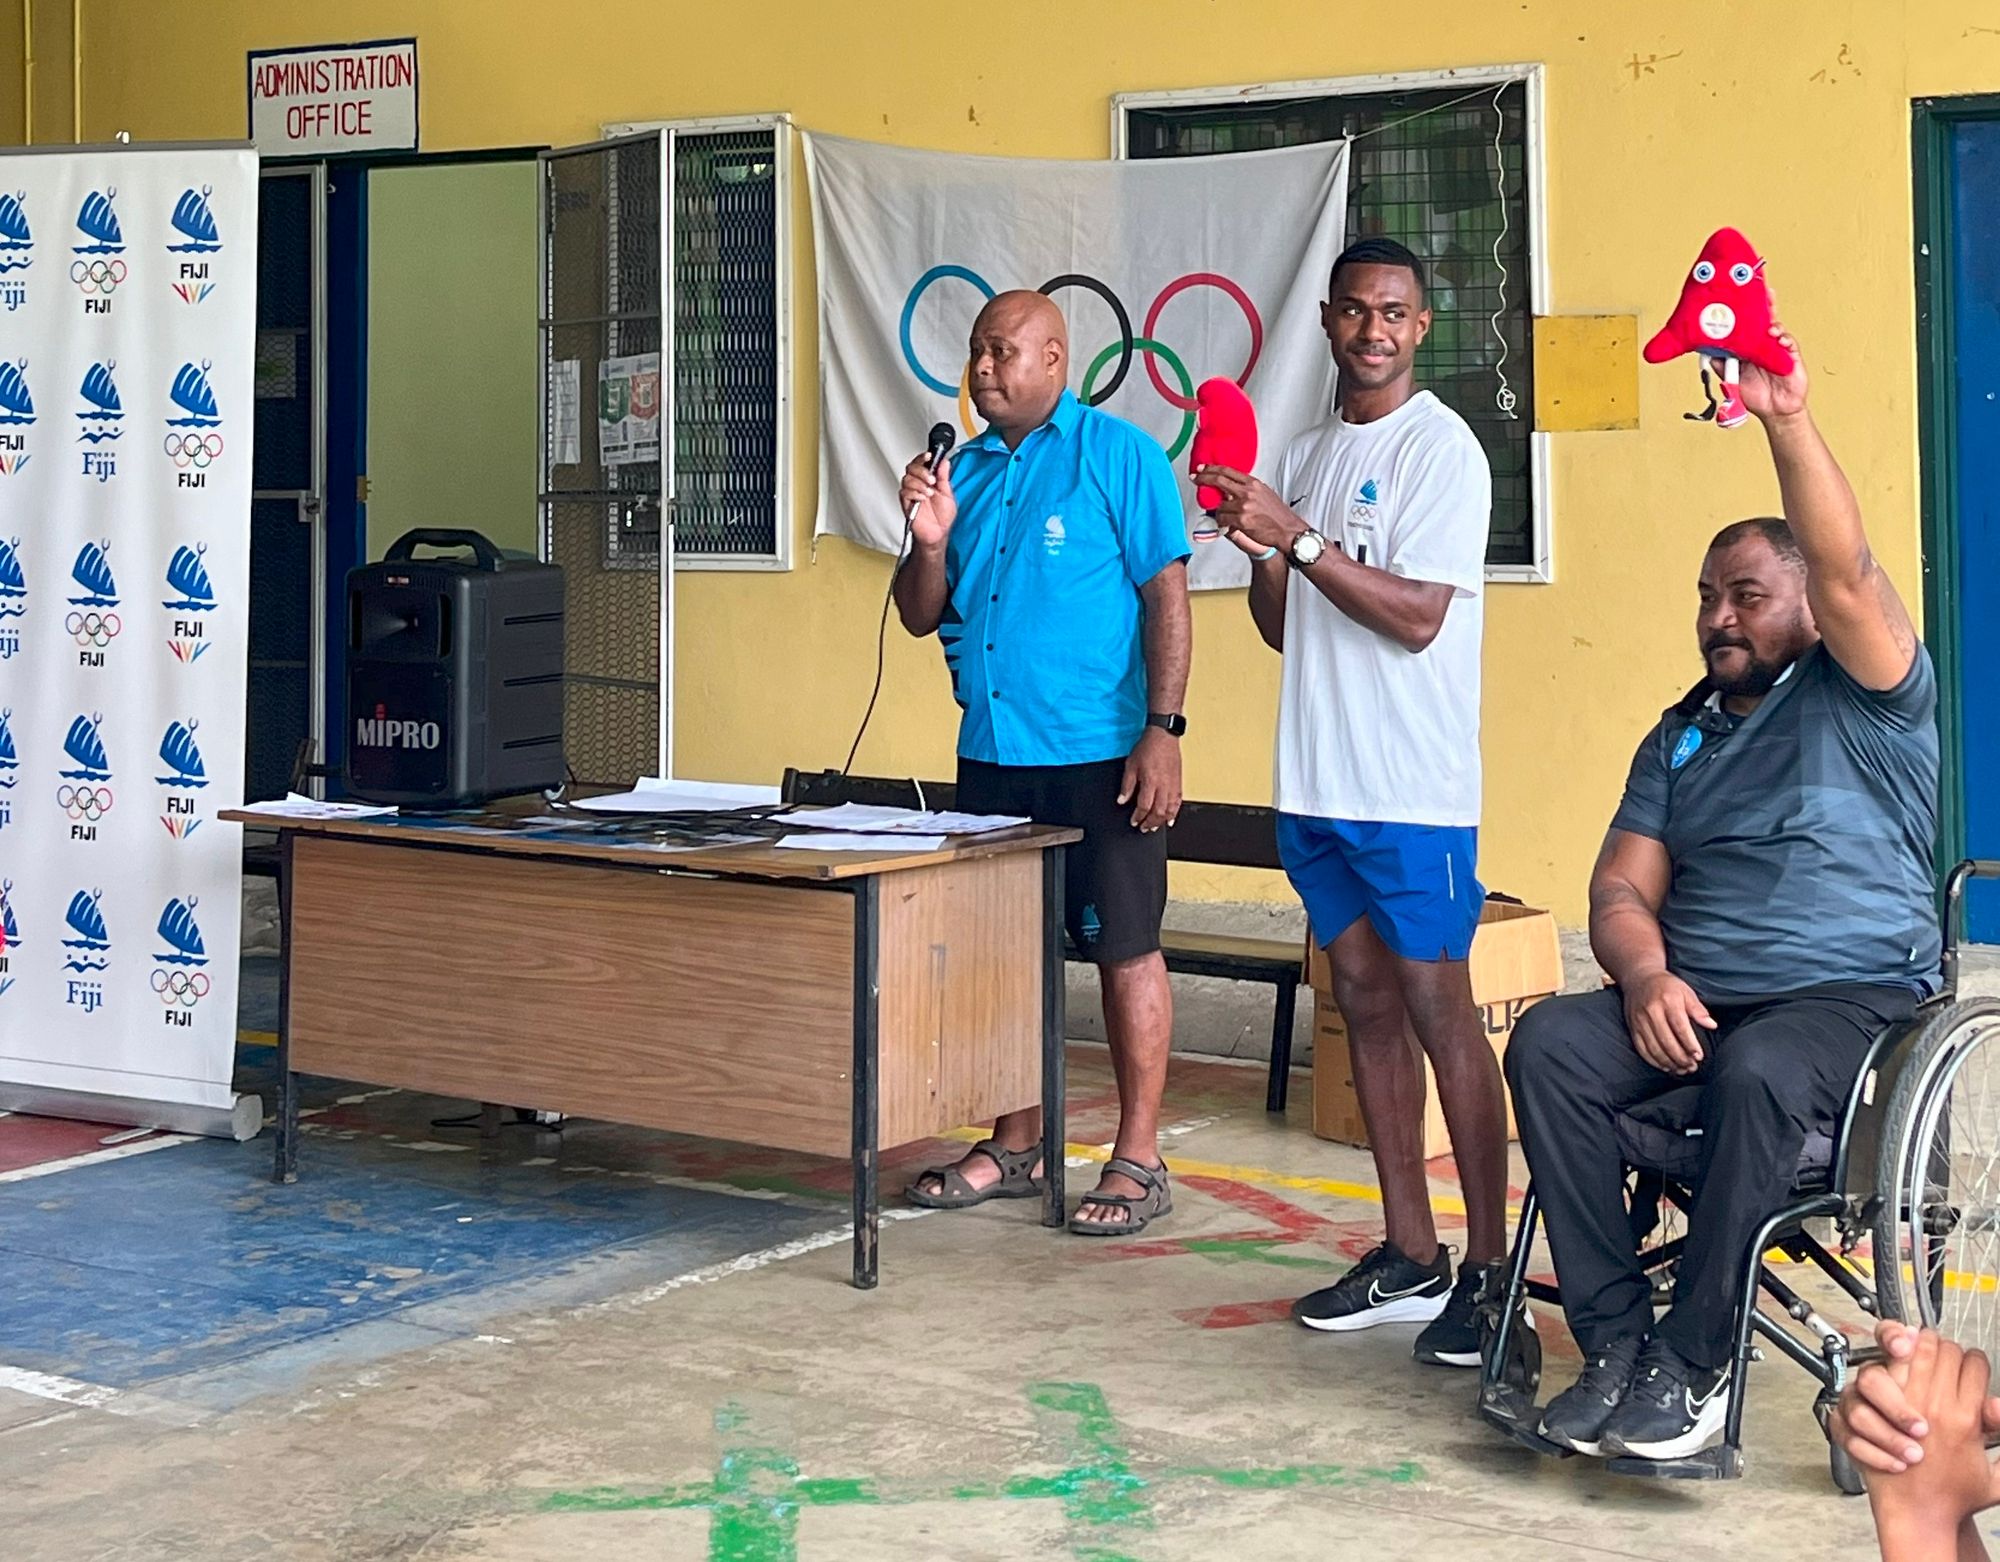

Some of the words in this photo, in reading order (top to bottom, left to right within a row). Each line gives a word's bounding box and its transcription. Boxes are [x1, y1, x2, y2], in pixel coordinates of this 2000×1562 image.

[254, 53, 412, 98] ADMINISTRATION
[286, 100, 372, 139] OFFICE
[180, 262, 209, 279] FIJI
[85, 298, 111, 314] FIJI
[81, 452, 117, 482] Fiji
[178, 472, 206, 488] FIJI
[174, 620, 203, 638] FIJI
[79, 651, 105, 668] FIJI
[357, 718, 440, 749] MIPRO
[167, 796, 195, 815] FIJI
[70, 824, 97, 841] FIJI
[66, 980, 103, 1013] Fiji
[165, 1009, 192, 1027] FIJI
